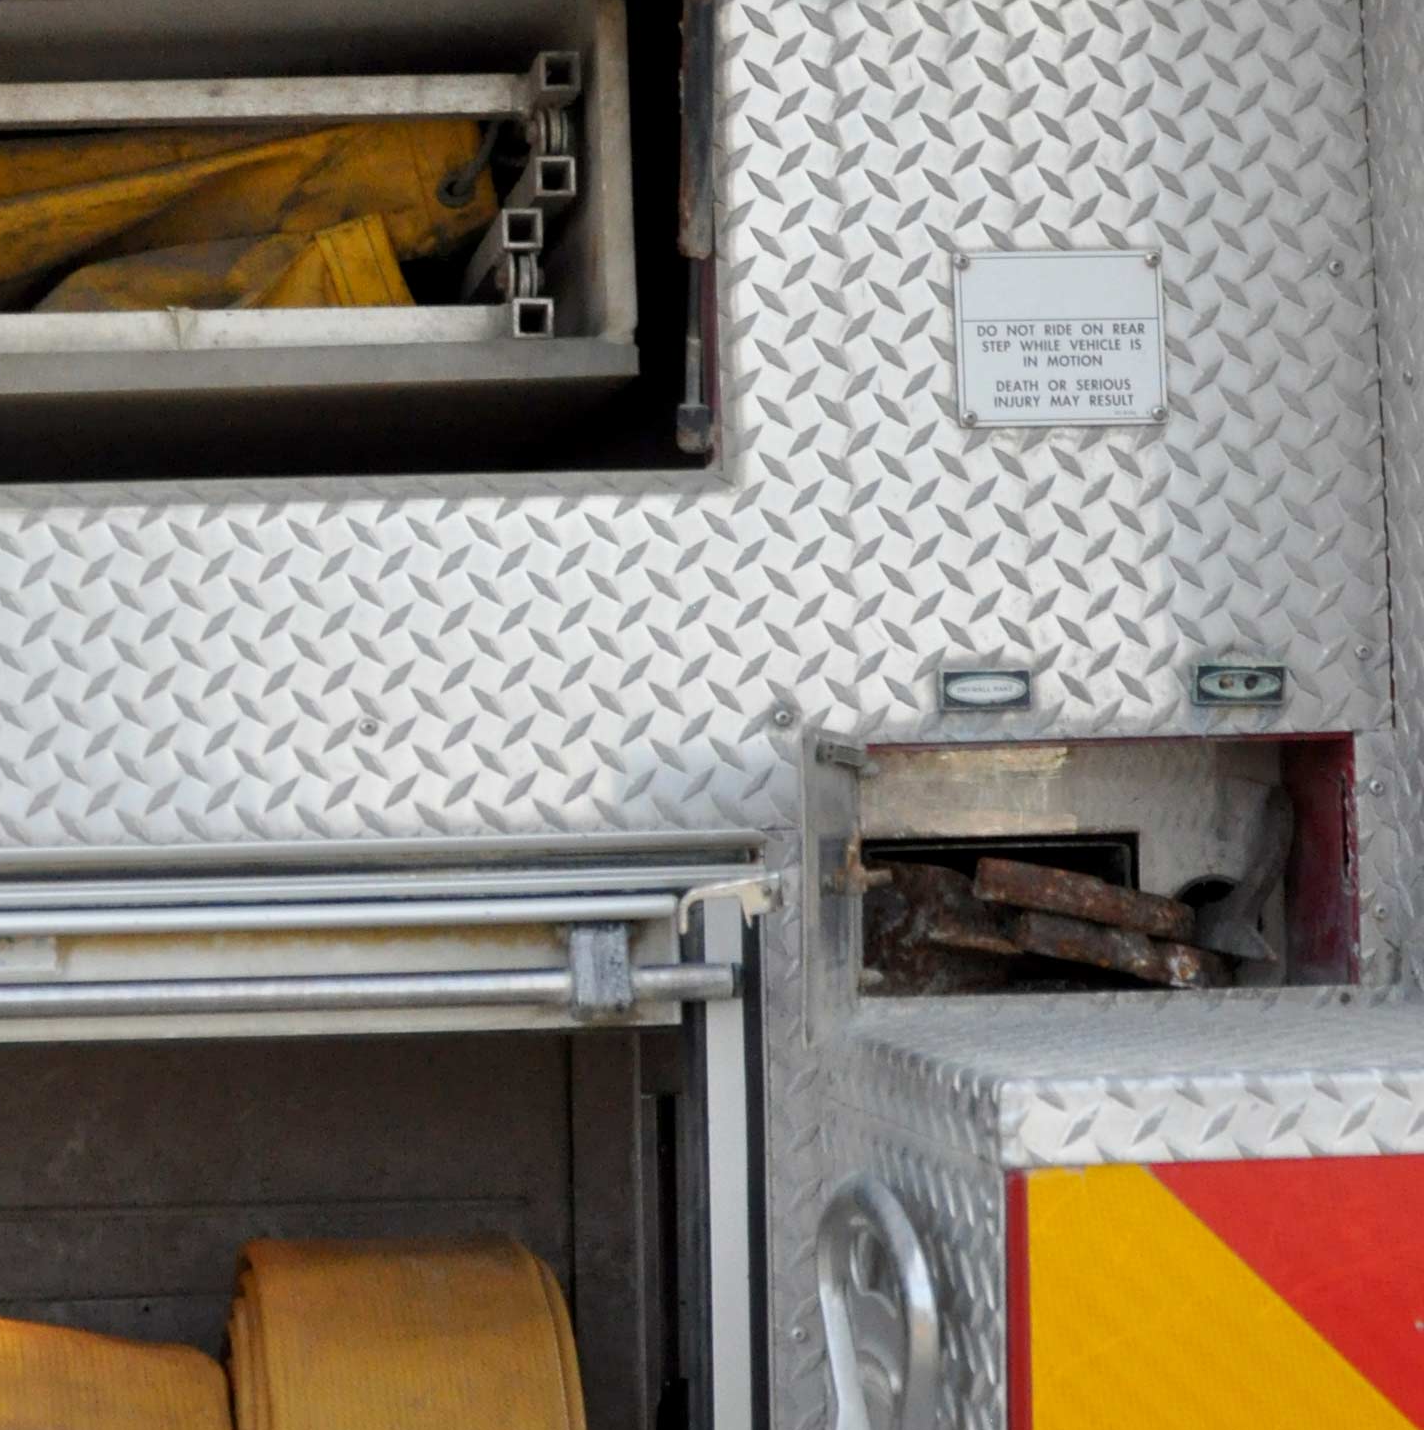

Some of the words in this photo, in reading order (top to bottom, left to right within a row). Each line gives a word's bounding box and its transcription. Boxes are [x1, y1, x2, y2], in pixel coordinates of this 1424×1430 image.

[977, 325, 998, 337] DO
[1006, 324, 1036, 337] NOT
[1044, 324, 1073, 336] RIDE
[1081, 323, 1104, 336] ON
[1112, 323, 1145, 335] REAR
[982, 340, 1011, 353] STEP
[1020, 340, 1061, 352] WHILE
[1070, 339, 1121, 351] VEHICLE
[1130, 338, 1142, 350] IS
[1023, 355, 1038, 368] IN
[1047, 355, 1103, 367] MOTION
[996, 380, 1039, 392] DEATH
[1048, 379, 1066, 391] OR
[1076, 378, 1132, 391] SERIOUS
[994, 396, 1040, 408] INJURY
[1050, 395, 1080, 407] MAY
[1089, 394, 1134, 407] RESULT
